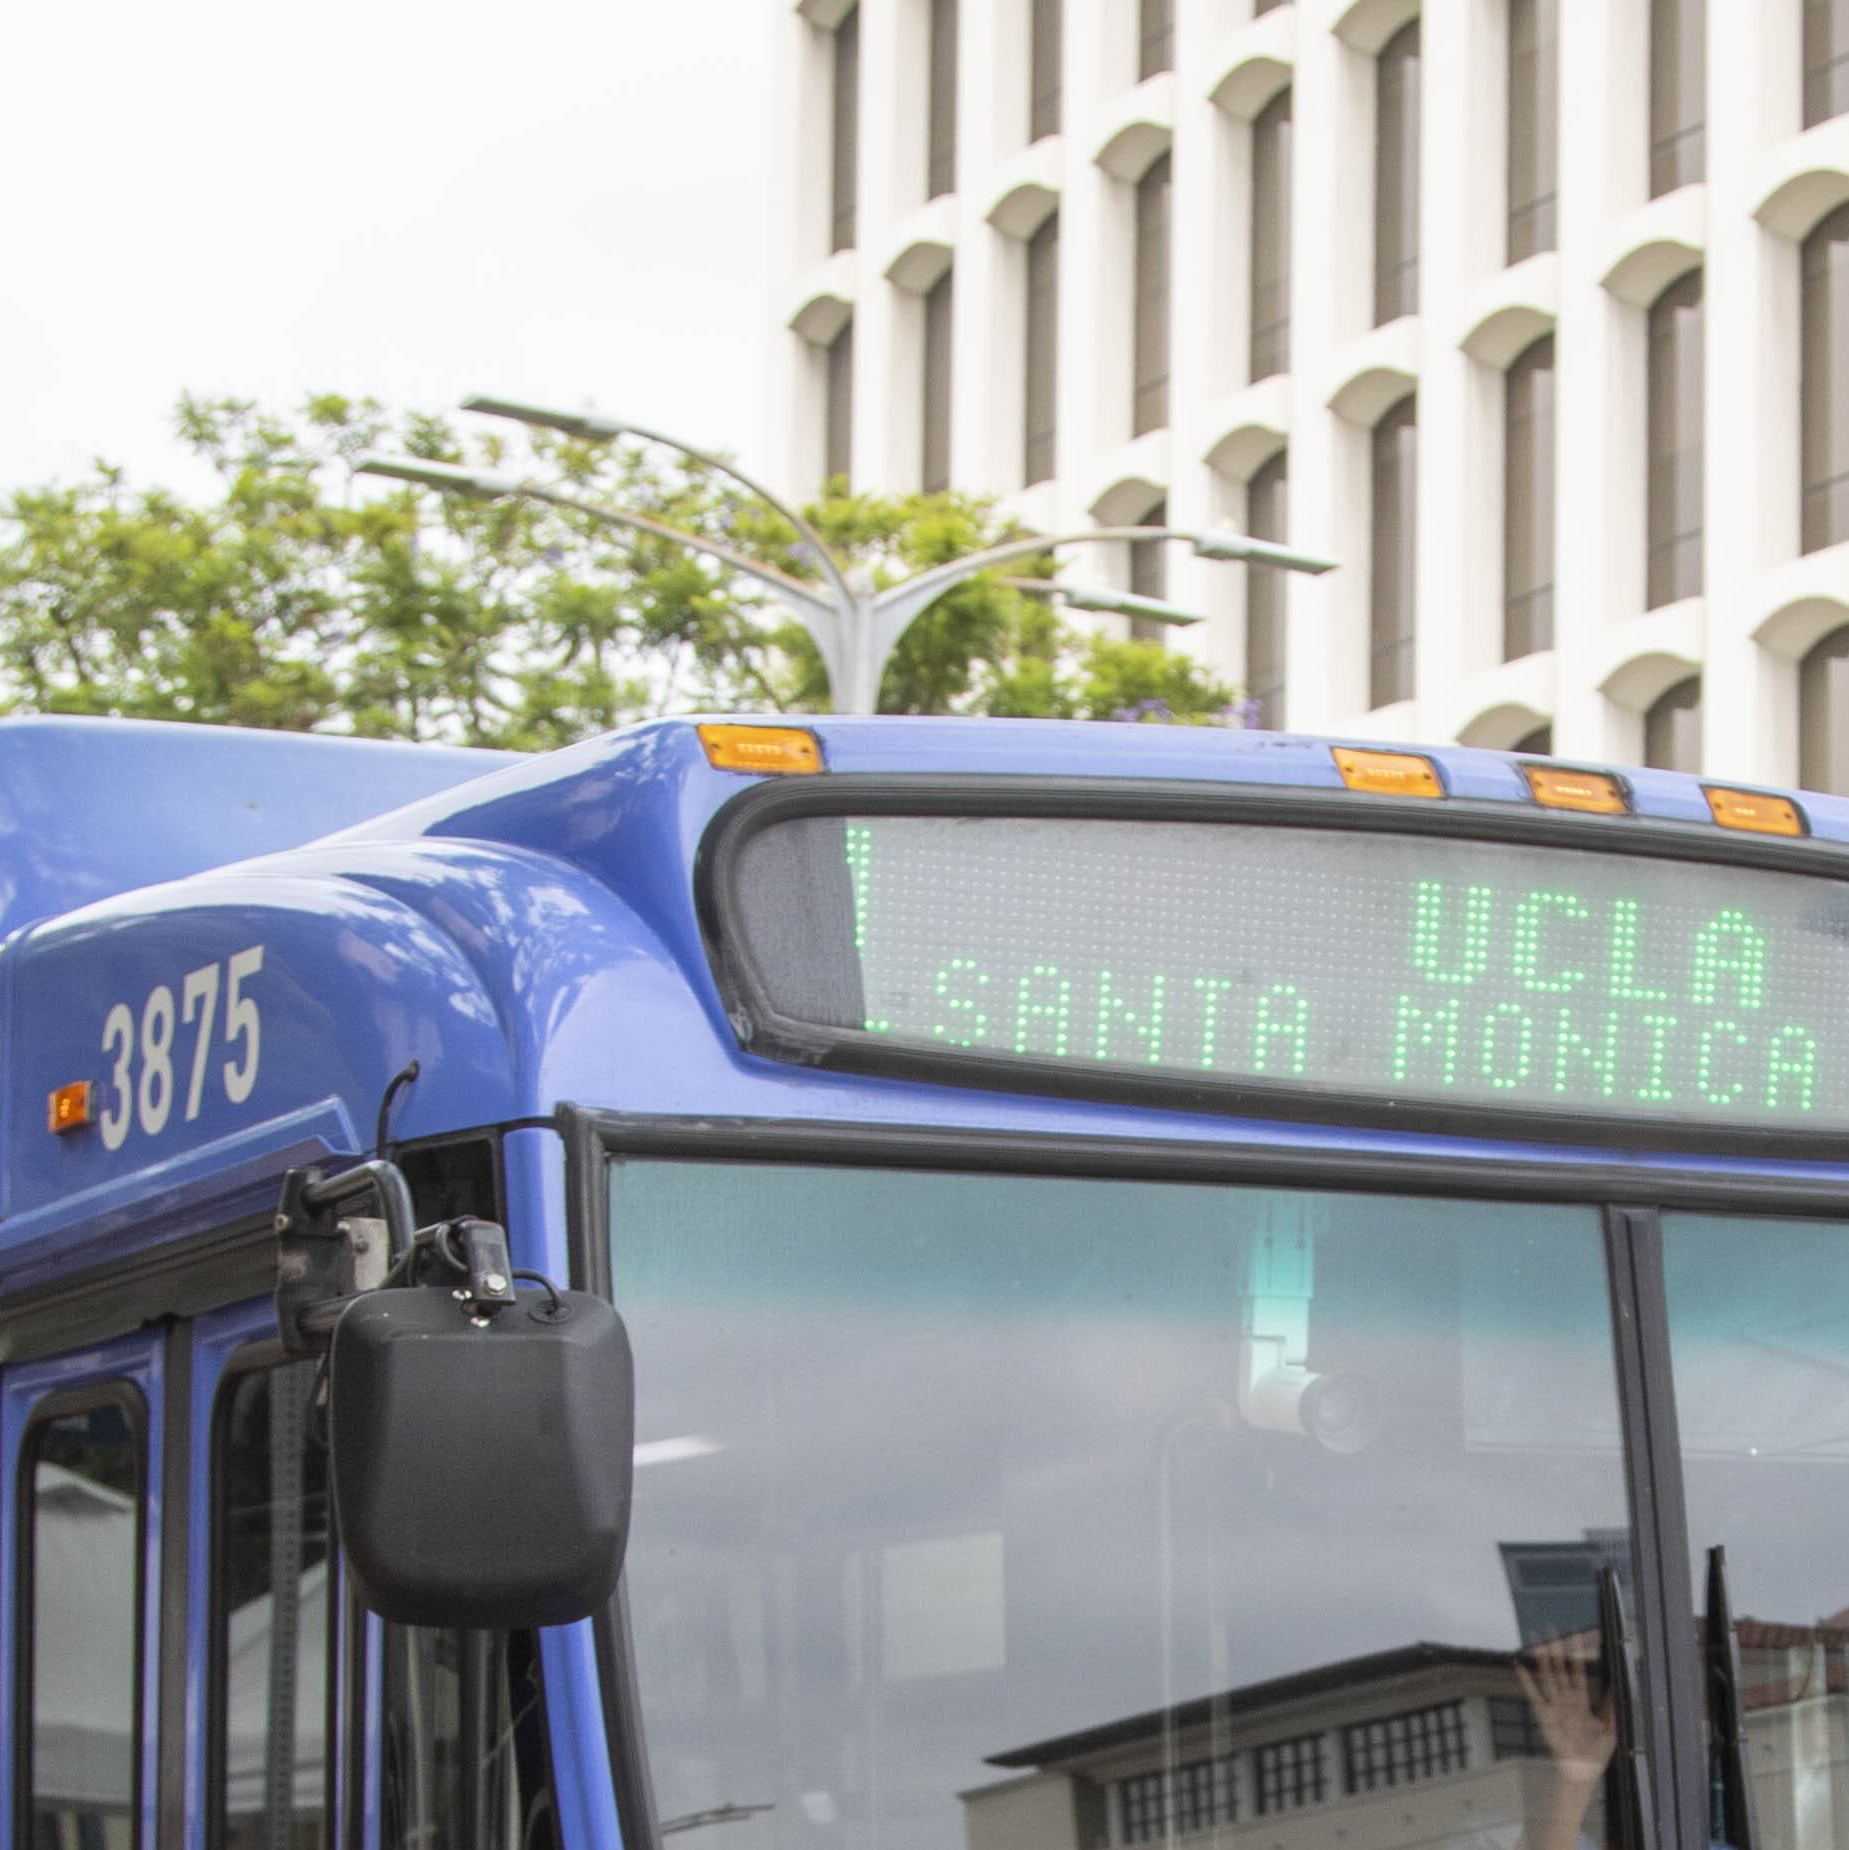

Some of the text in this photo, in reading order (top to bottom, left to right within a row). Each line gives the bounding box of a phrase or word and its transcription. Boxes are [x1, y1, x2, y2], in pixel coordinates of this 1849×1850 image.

[1412, 881, 1766, 1008] UCLA
[99, 944, 265, 1152] 3875
[932, 956, 1310, 1074] SANTA
[1392, 995, 1817, 1111] MONICA
